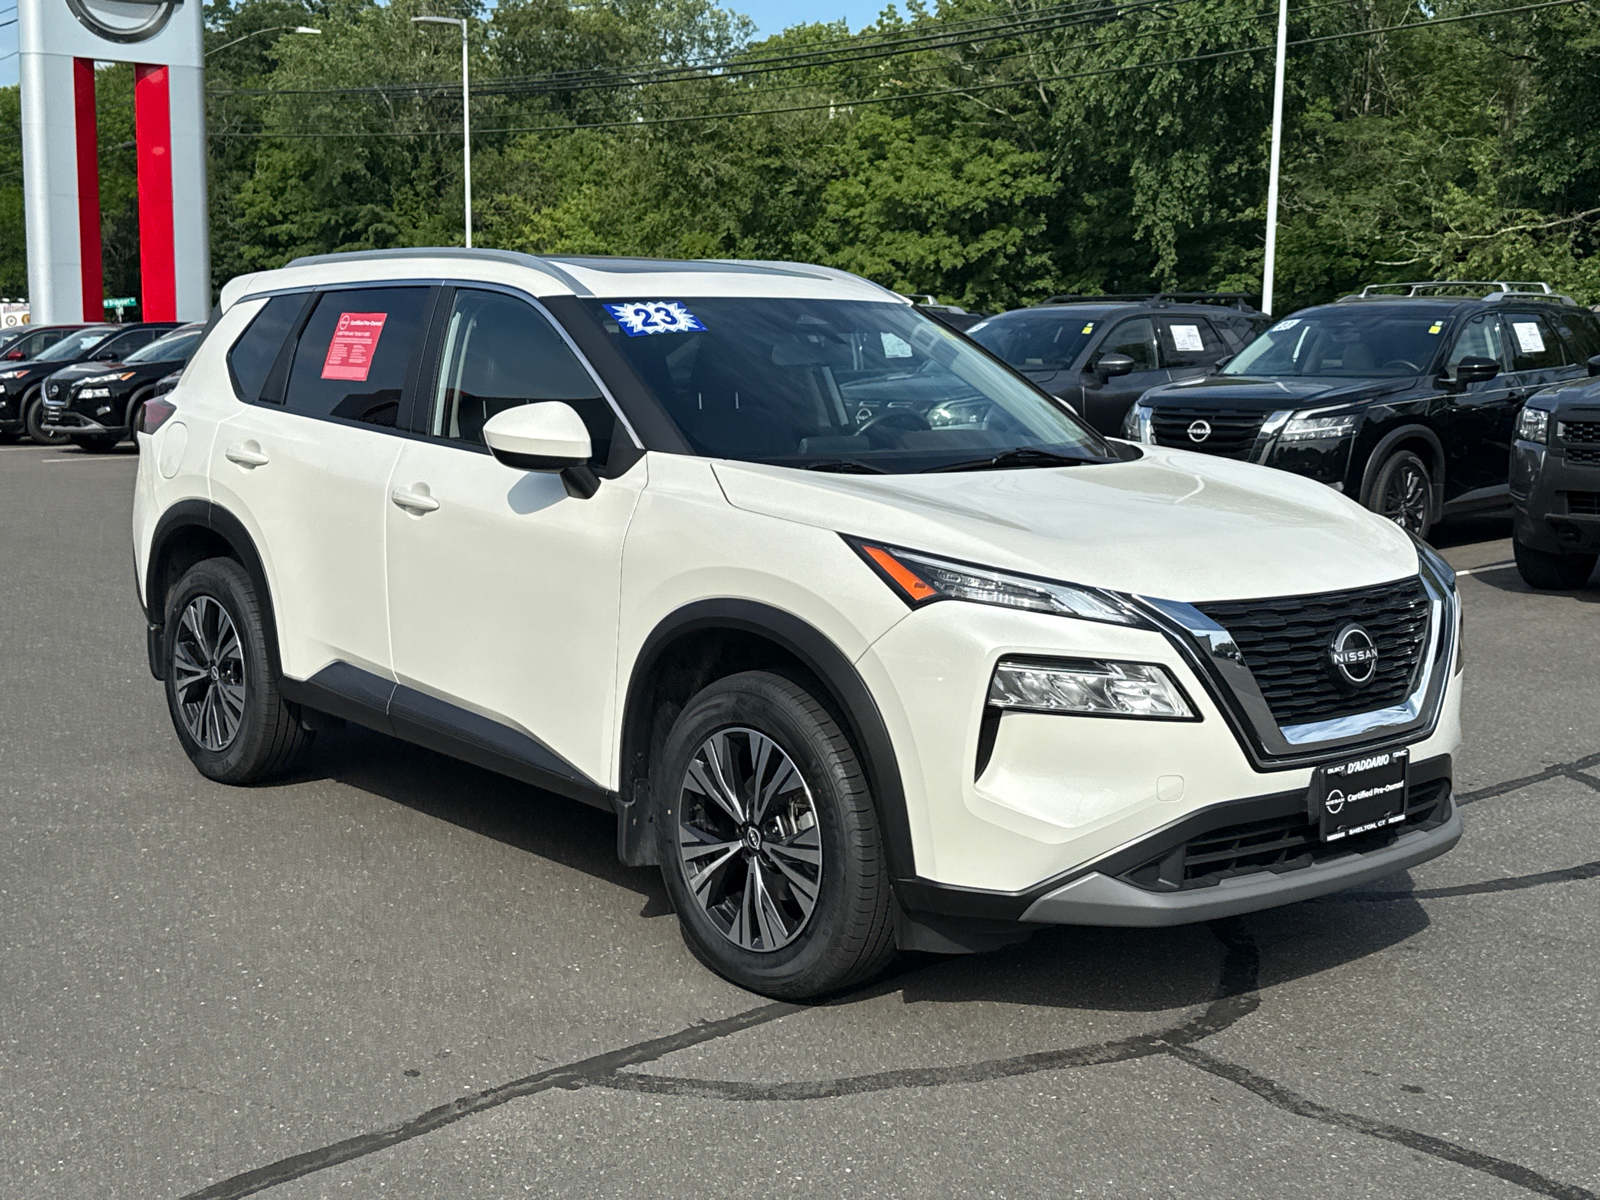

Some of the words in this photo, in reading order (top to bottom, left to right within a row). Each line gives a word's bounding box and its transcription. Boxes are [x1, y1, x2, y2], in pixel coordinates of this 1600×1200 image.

[633, 306, 678, 328] 23
[1333, 646, 1378, 664] NISSAN
[1328, 766, 1345, 774] BUICK
[1347, 754, 1389, 774] D'ADDARIO
[1392, 750, 1408, 758] GMC
[1347, 789, 1373, 802] Certified
[1374, 780, 1404, 795] Pre-Owned
